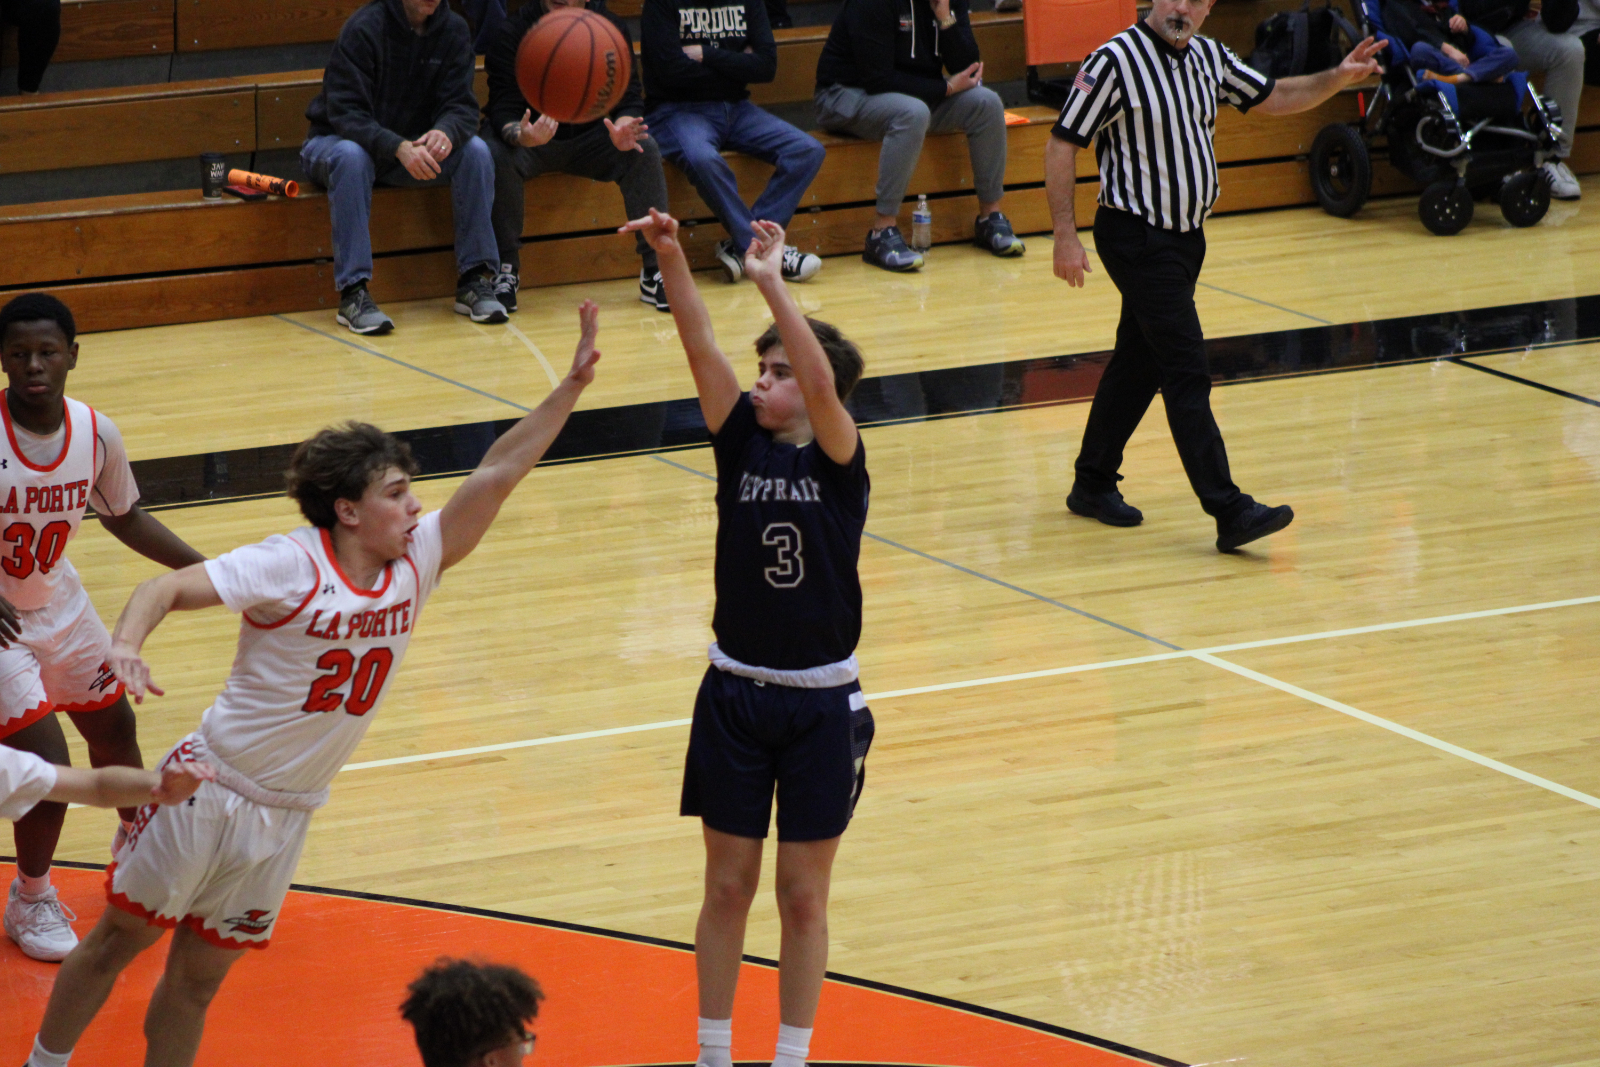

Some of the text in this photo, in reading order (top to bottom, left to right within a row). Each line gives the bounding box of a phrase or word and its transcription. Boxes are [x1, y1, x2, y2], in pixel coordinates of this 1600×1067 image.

[678, 5, 747, 33] PURDUE
[23, 479, 89, 514] PORTE
[1, 519, 71, 580] 30
[761, 522, 805, 589] 3
[305, 598, 412, 640] LA PORTE
[301, 646, 394, 717] 20
